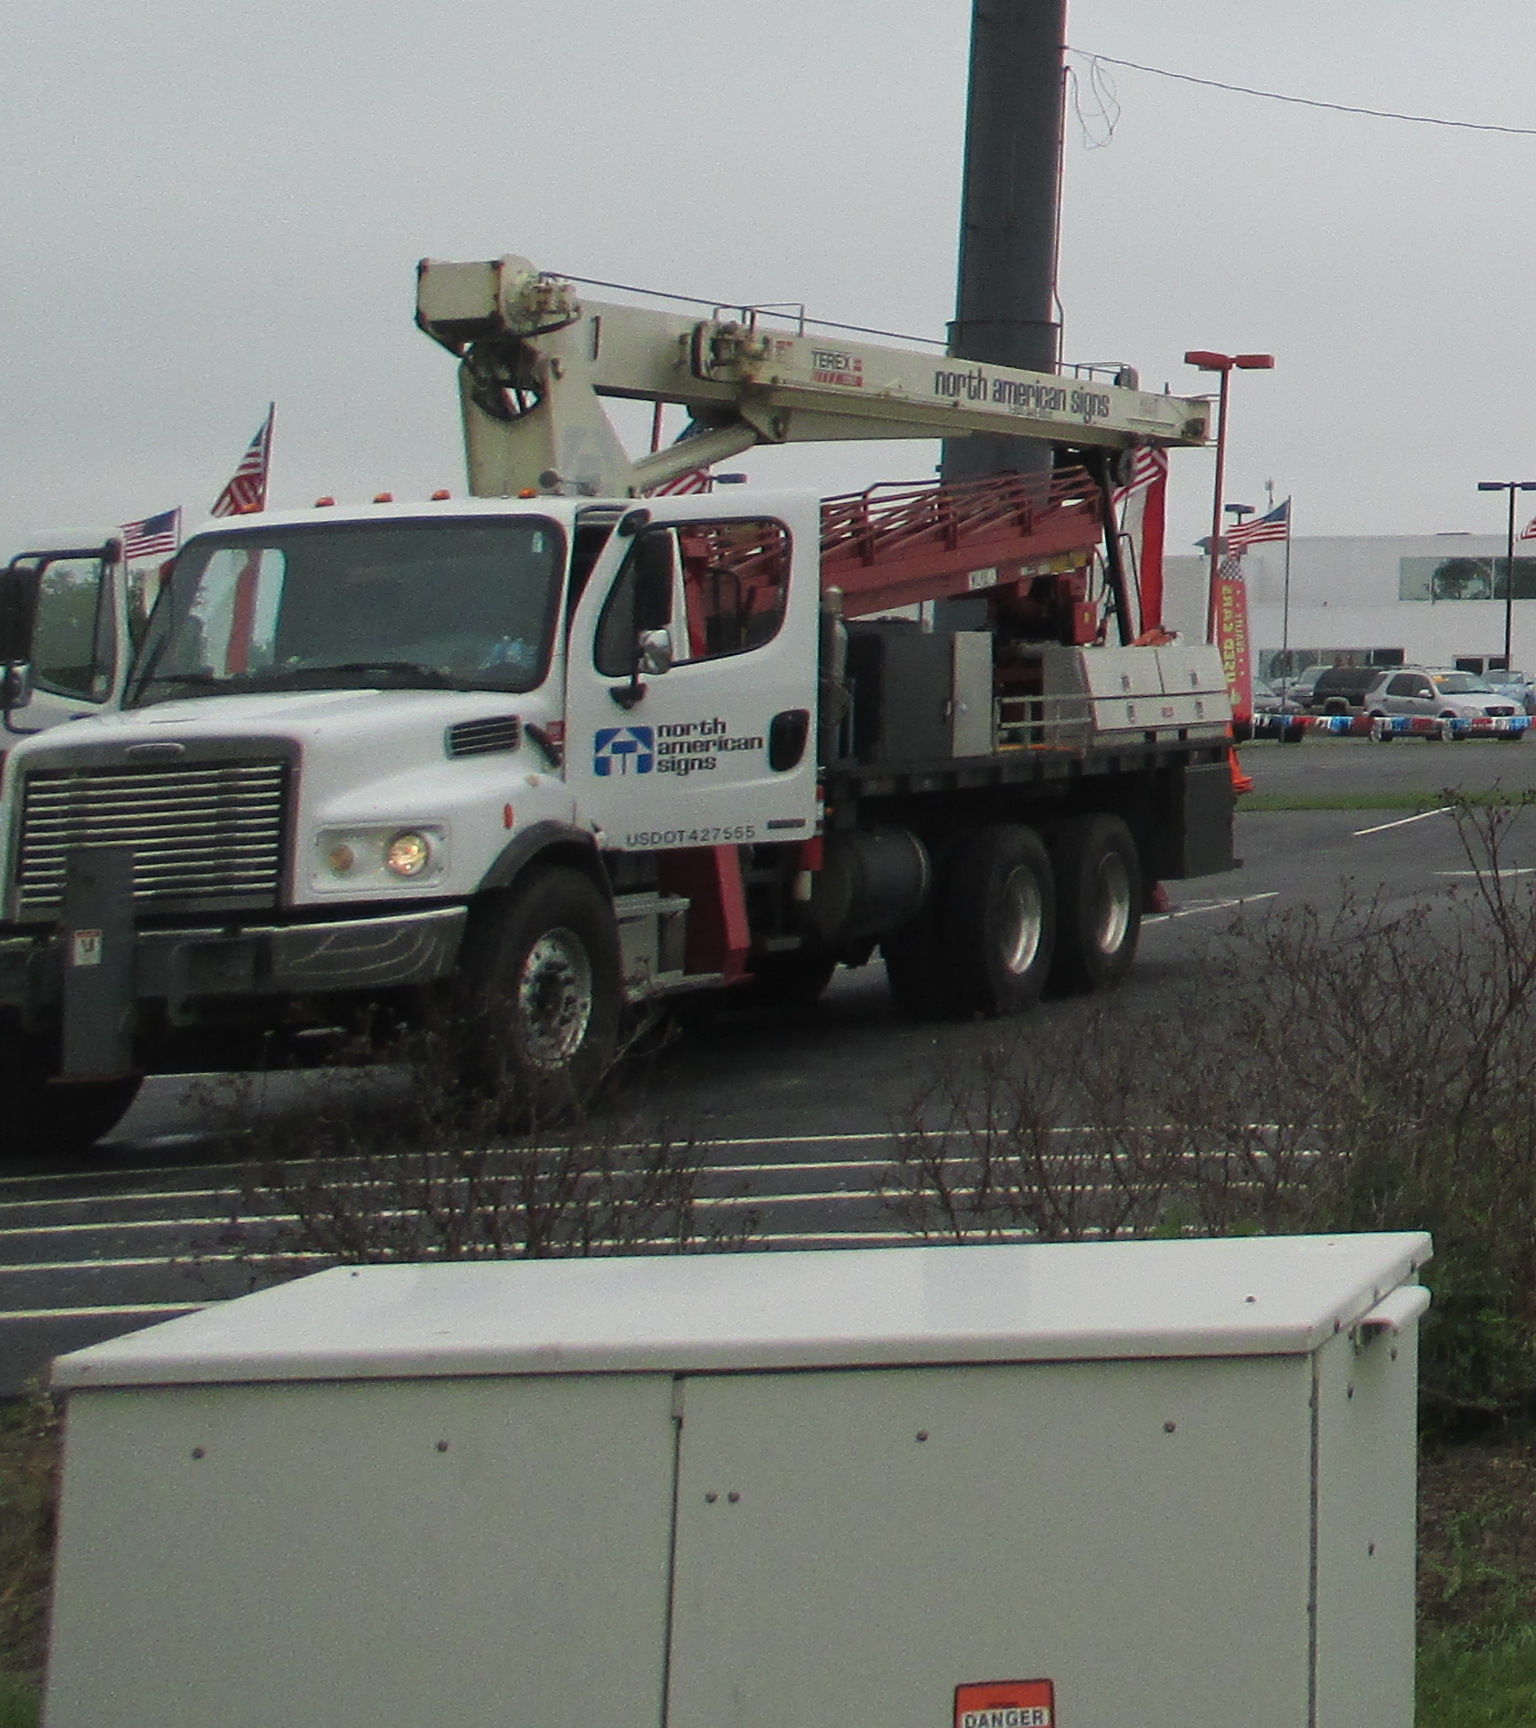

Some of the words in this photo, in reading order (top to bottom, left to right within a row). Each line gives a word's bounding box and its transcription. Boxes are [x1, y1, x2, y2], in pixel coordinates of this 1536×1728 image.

[811, 349, 852, 372] TEREX
[935, 367, 989, 401] north
[992, 378, 1067, 412] american
[1071, 386, 1110, 423] signs
[658, 718, 726, 737] north
[658, 736, 763, 755] american
[657, 755, 717, 776] signs
[965, 1709, 1044, 1728] DANGER
